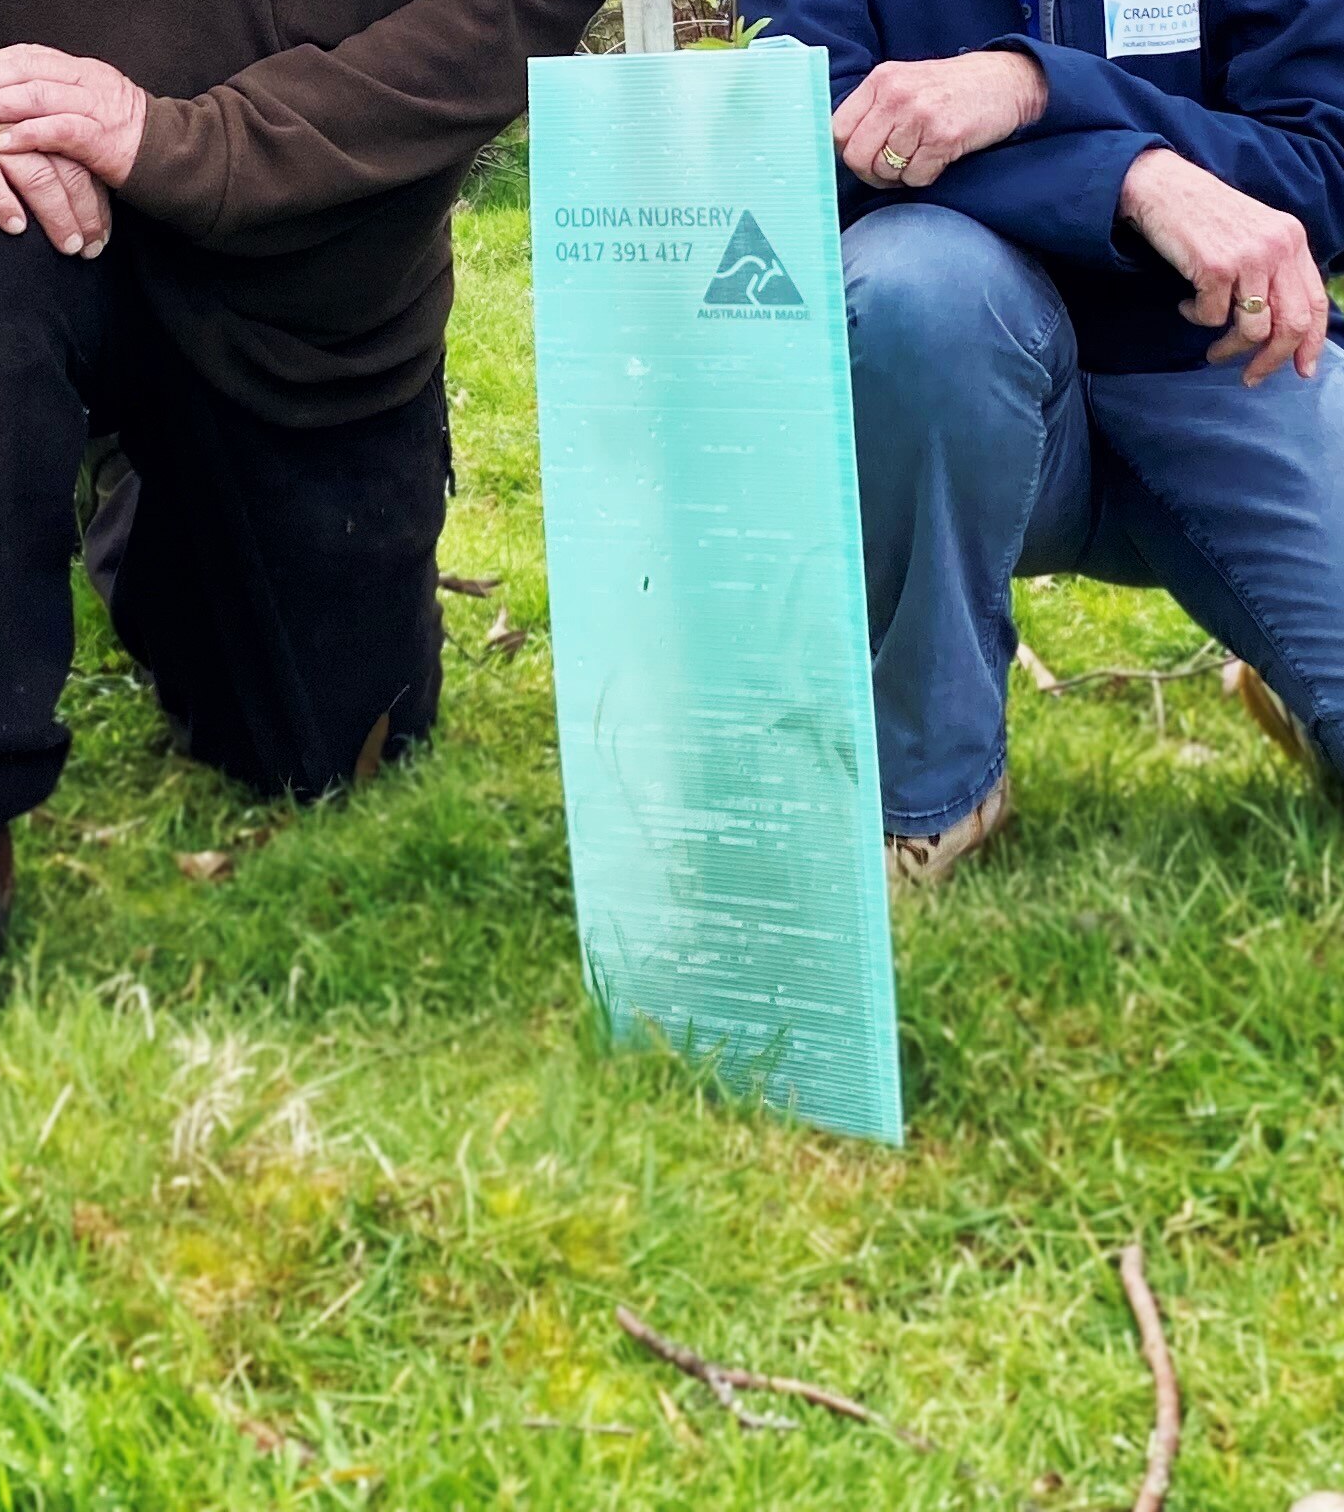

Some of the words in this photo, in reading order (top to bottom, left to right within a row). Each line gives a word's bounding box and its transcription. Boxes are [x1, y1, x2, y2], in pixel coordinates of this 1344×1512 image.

[1123, 6, 1174, 20] CRADLE
[1176, 3, 1199, 16] COA
[1124, 18, 1199, 32] AUTHORI
[556, 207, 633, 228] OLDINA
[638, 206, 734, 227] NURSERY
[556, 242, 605, 262] 0417
[612, 242, 649, 262] 391
[655, 241, 694, 262] 417
[697, 308, 771, 320] AUSTRALIAN
[775, 309, 811, 322] MADE
